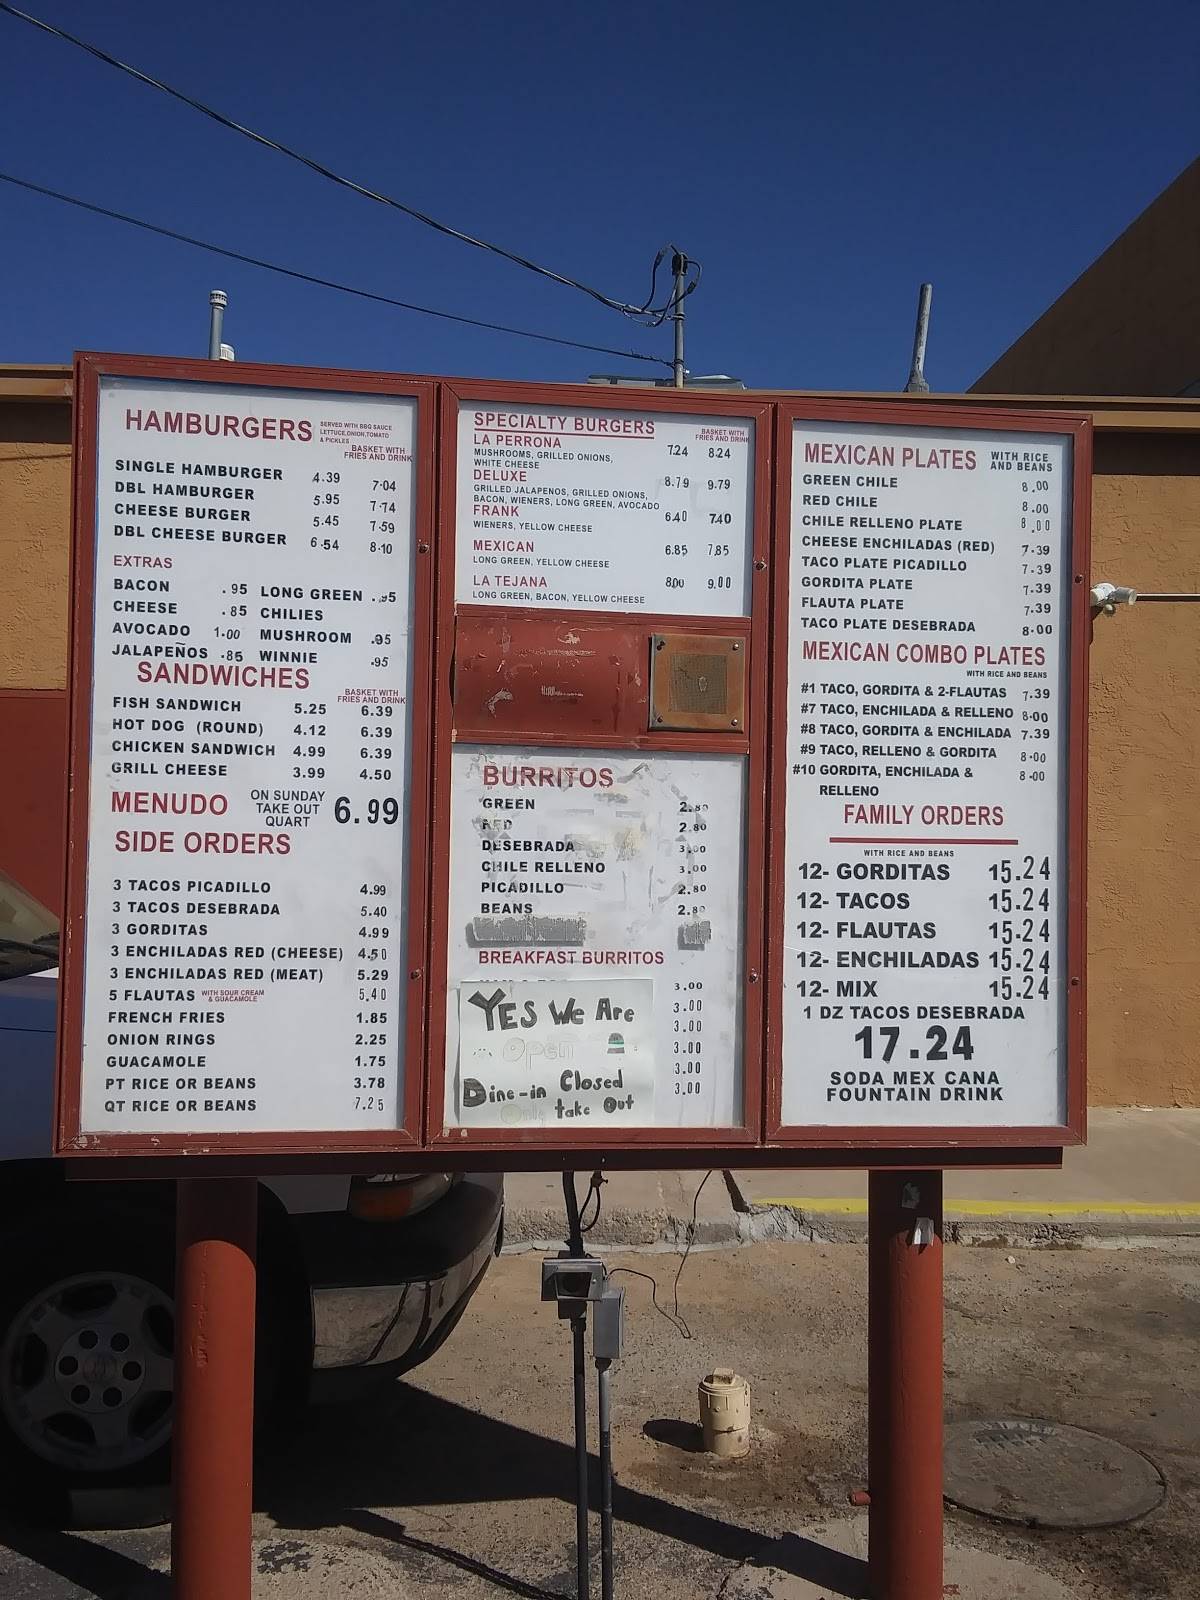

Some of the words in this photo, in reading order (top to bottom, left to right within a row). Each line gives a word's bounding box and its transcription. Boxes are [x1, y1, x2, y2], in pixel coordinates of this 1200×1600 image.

[126, 408, 313, 442] HAMBURGERS
[474, 411, 567, 431] SPECIALTY
[574, 417, 655, 434] BURGERS
[473, 433, 491, 446] LA
[496, 434, 562, 449] PERRONA
[343, 451, 367, 460] FRIES
[368, 453, 386, 461] AND
[388, 454, 412, 462] DRINK
[351, 444, 384, 453] BASKET
[385, 446, 406, 455] WITH
[474, 447, 534, 460] MUSHROOMS,
[536, 451, 575, 461] GRILLED
[577, 452, 613, 464] ONIONS,
[804, 442, 895, 467] MEXICAN
[902, 447, 977, 471] PLATES
[473, 458, 502, 468] WHITE
[504, 459, 540, 470] CHEESE
[990, 451, 1019, 462] WITH
[1023, 452, 1049, 463] RICE
[115, 459, 175, 474] SINGLE
[181, 463, 283, 481] HAMBURGER
[990, 460, 1012, 471] AND
[1016, 461, 1053, 473] BEANS
[473, 468, 527, 482] DELUXE
[802, 474, 851, 487] GREEN
[856, 476, 898, 488] CHILE
[707, 478, 731, 491] 9.79
[473, 494, 508, 505] BACON,
[510, 496, 553, 507] WIENERS,
[555, 498, 580, 507] LONG
[582, 499, 615, 509] GREEN,
[617, 500, 660, 510] AVOCADO
[473, 504, 519, 517] FRANK
[473, 520, 516, 531] WIENERS,
[518, 522, 556, 531] YELLOW
[557, 523, 593, 533] CHEESE
[114, 524, 145, 538] DBL
[151, 526, 215, 542] CHEESE
[222, 530, 287, 545] BURGER
[473, 539, 534, 553] MEXICAN
[665, 544, 688, 557] 6.85
[801, 535, 858, 548] CHEESE
[863, 537, 952, 551] ENCHILADAS
[957, 540, 995, 555] (RED)
[113, 554, 173, 569] EXTRAS
[113, 578, 170, 592] BACON
[473, 574, 491, 586] LA
[494, 575, 548, 588] TEJANA
[707, 575, 731, 590] 9.00
[472, 590, 497, 599] LONG
[499, 591, 533, 601] GREEN,
[535, 592, 569, 602] BACON,
[572, 593, 608, 603] YELLOW
[610, 595, 645, 604] CHEESE
[113, 600, 178, 614] CHEESE
[260, 607, 323, 621] CHILIES
[112, 622, 191, 637] AVOCADO
[800, 617, 838, 629] TACO
[843, 618, 887, 630] PLATE
[892, 619, 976, 632] DESEBRADA
[260, 628, 352, 644] MUSHROOM
[259, 650, 318, 664] WINNIE
[802, 640, 889, 662] MEXICAN
[896, 643, 967, 665] COMBO
[974, 645, 1046, 666] PLATES
[137, 661, 310, 690] SANDWICHES
[987, 670, 1004, 678] RICE
[1023, 671, 1048, 679] BEANS
[800, 682, 815, 694] #1
[819, 683, 859, 697] TACO,
[862, 684, 921, 696] GORDITA
[924, 685, 934, 697] &
[937, 686, 1007, 698] 2-FLAUTAS
[1022, 688, 1050, 702] 7.39
[113, 696, 149, 709] FISH
[156, 697, 241, 712] SANDWICH
[294, 702, 327, 715] 5.25
[361, 704, 393, 717] 6.39
[112, 718, 145, 731] HOT
[151, 719, 185, 732] DOG
[196, 721, 263, 737] (ROUND)
[293, 724, 326, 737] 4.12
[360, 726, 393, 739] 6.39
[483, 765, 614, 790] BURRITOS
[250, 789, 269, 801] ON
[273, 789, 326, 802] SUNDAY
[111, 791, 228, 816] MENUDO
[255, 802, 290, 814] TAKE
[293, 803, 321, 815] OUT
[482, 796, 535, 810] GREEN
[334, 796, 399, 825] 6.99
[844, 804, 914, 825] FAMILY
[921, 805, 1004, 826] ORDERS
[265, 815, 311, 828] QUART
[115, 830, 175, 853] SIDE
[184, 831, 291, 855] ORDERS
[481, 860, 528, 873] CHILE
[534, 861, 606, 873] RELLENO
[798, 862, 830, 880] 12-
[836, 862, 950, 881] GORDITAS
[988, 855, 1051, 884] 15.24
[113, 879, 122, 891] 3
[128, 879, 181, 892] TACOS
[187, 880, 271, 894] PICADILLO
[359, 883, 386, 896] 4.99
[796, 891, 830, 909] 12-
[835, 892, 910, 910] TACOS
[988, 887, 1050, 914] 15.24
[481, 902, 533, 914] BEANS
[796, 921, 829, 939] 12-
[836, 921, 937, 939] FLAUTAS
[478, 950, 577, 965] BREAKFAST
[582, 951, 664, 965] BURRITOS
[674, 981, 703, 991] 3.00
[108, 1011, 173, 1024] FRENCH
[179, 1011, 225, 1024] FRIES
[356, 1012, 387, 1024] 1.85
[547, 997, 585, 1026] We
[595, 997, 635, 1023] Are
[803, 1005, 811, 1020] 1
[820, 1005, 844, 1020] DZ
[850, 1005, 910, 1020] TACOS
[917, 1005, 1025, 1020] DESEBRADA
[854, 1024, 975, 1064] 17.24
[106, 1055, 206, 1068] GUACAMOLE
[354, 1055, 386, 1067] 1.75
[105, 1078, 126, 1090] PT
[131, 1078, 169, 1090] RICE
[175, 1077, 197, 1090] OR
[203, 1077, 256, 1090] BEANS
[353, 1077, 385, 1089] 3.78
[830, 1071, 885, 1086] SODA
[893, 1071, 935, 1085] MEX
[944, 1071, 1000, 1085] CANA
[462, 1077, 547, 1108] Dine-in
[559, 1068, 623, 1093] Closed
[826, 1087, 931, 1102] FOUNTAIN
[940, 1087, 1004, 1101] DRINK
